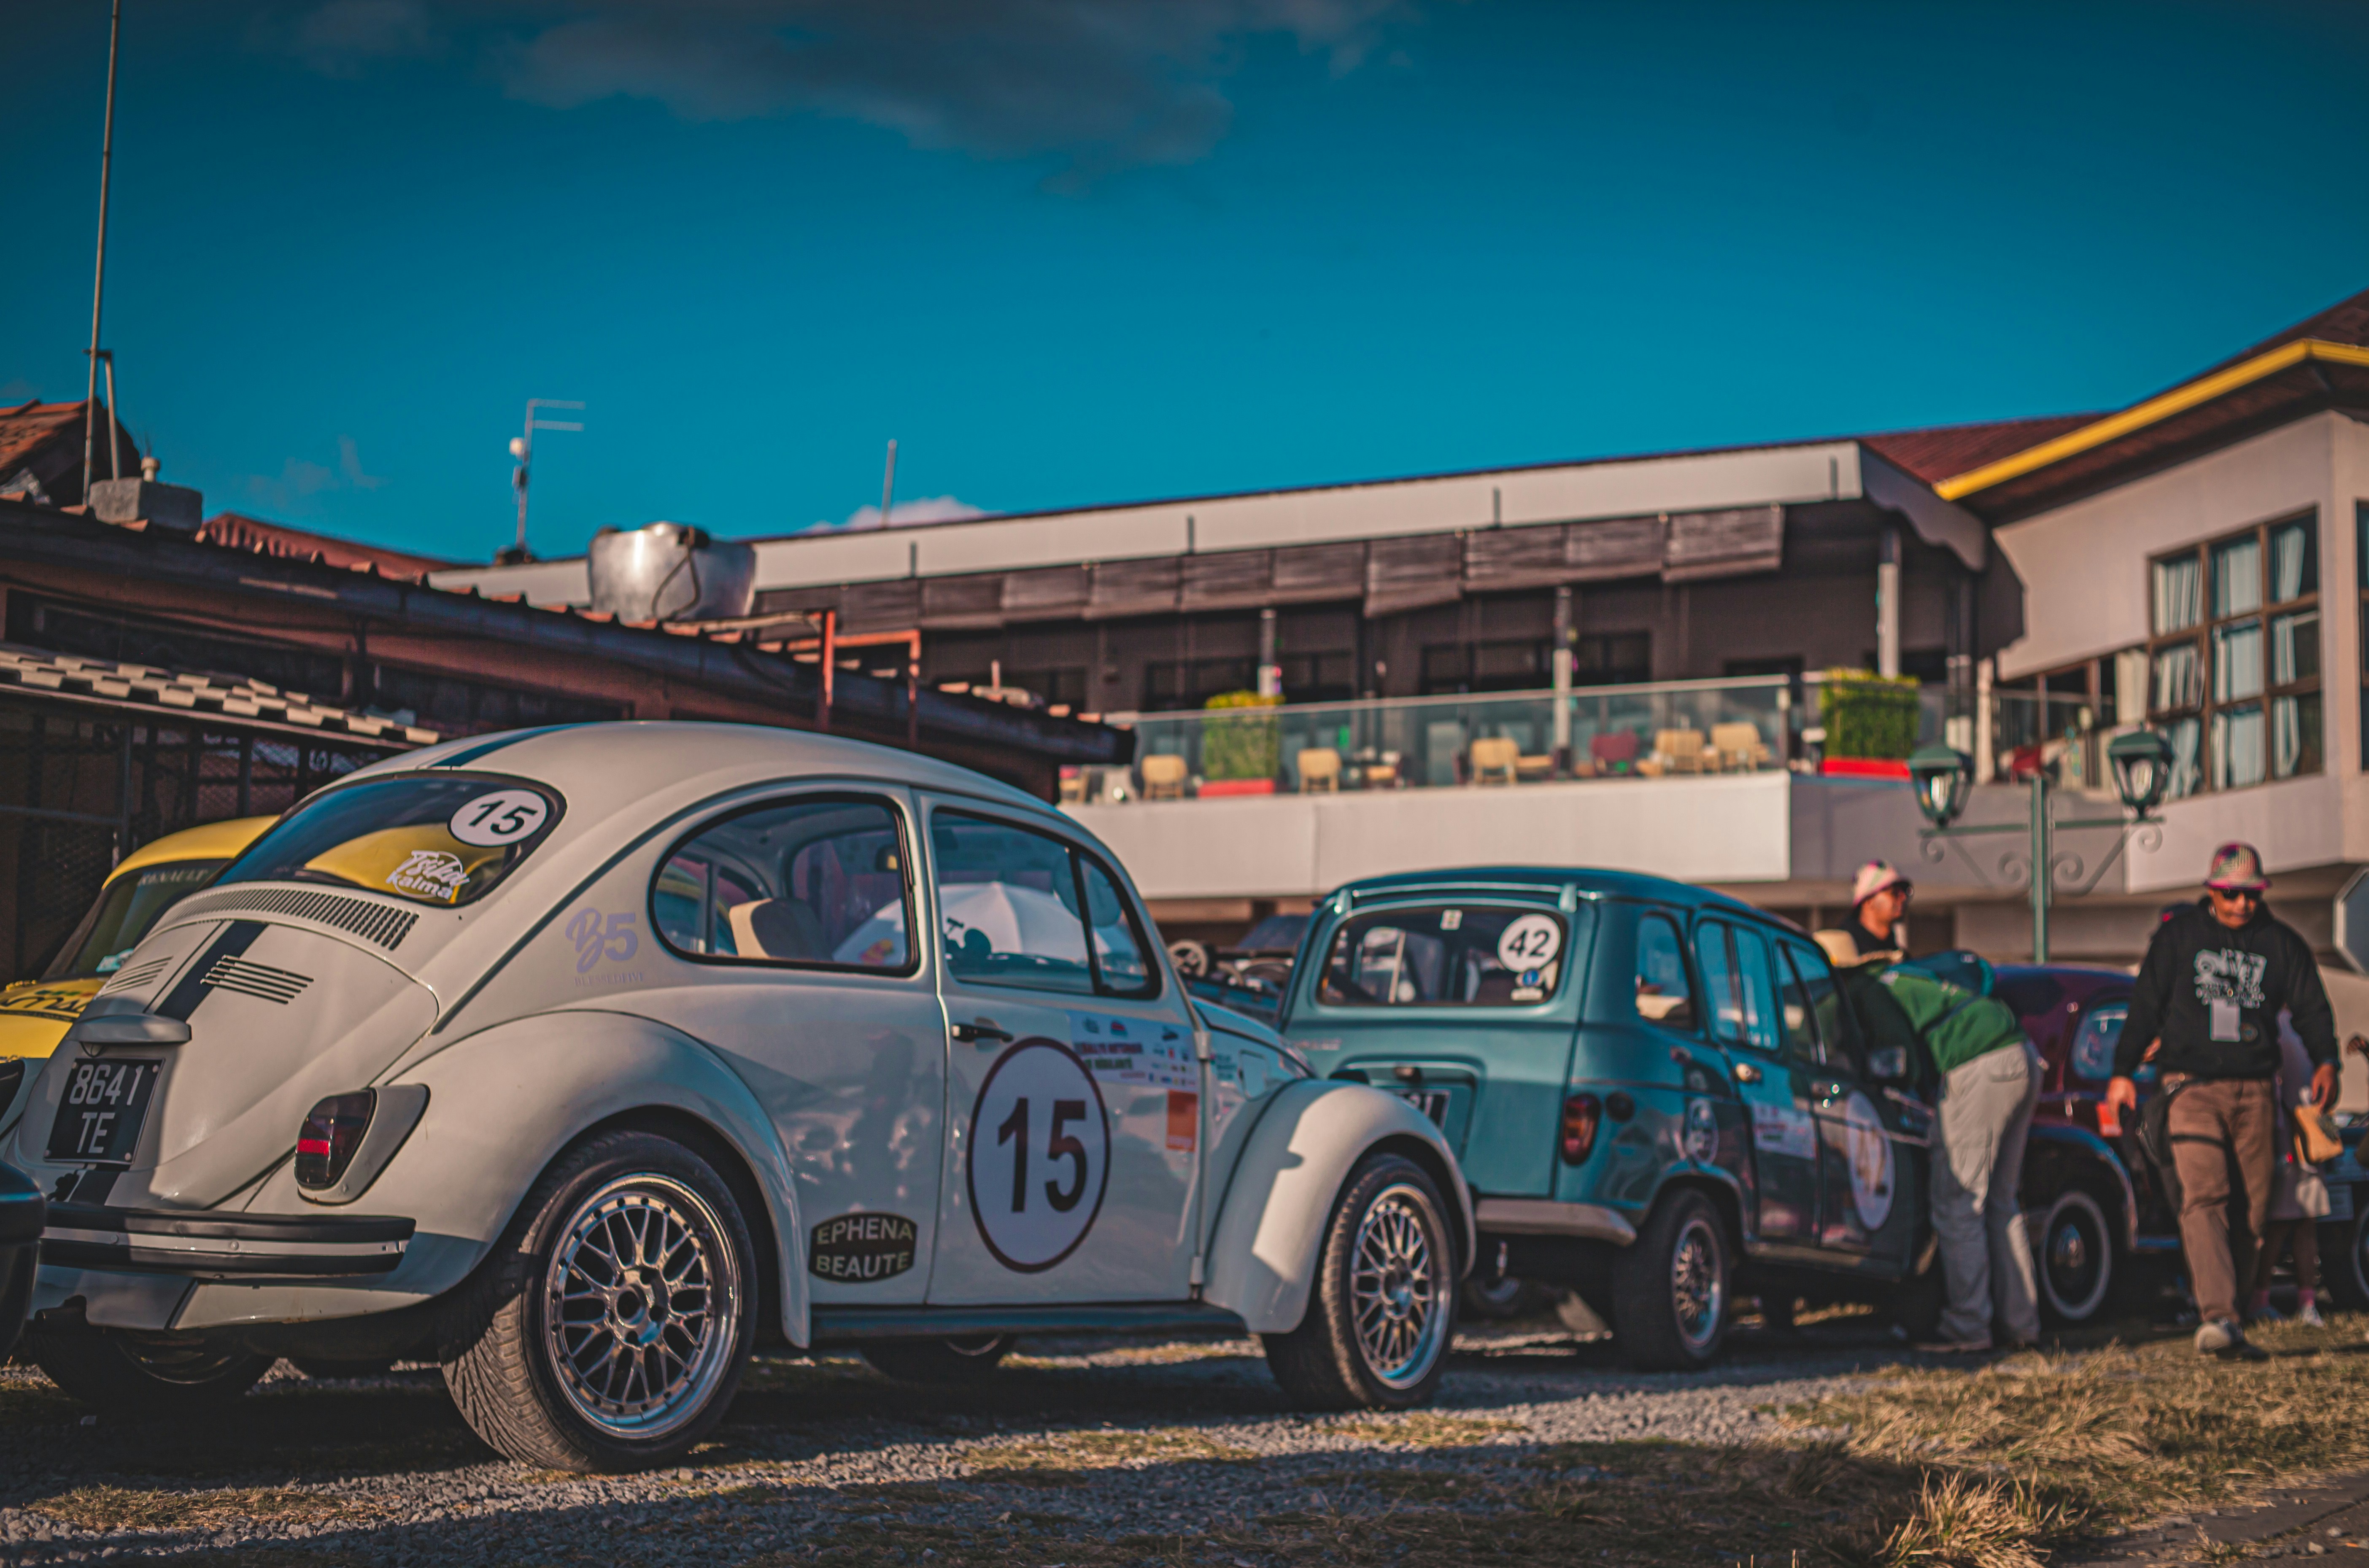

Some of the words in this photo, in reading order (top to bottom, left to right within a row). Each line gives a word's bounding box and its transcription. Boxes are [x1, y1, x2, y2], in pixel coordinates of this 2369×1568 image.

[469, 800, 538, 835] 15
[1508, 929, 1550, 957] 42
[69, 1064, 144, 1105] 8641
[77, 1112, 115, 1153] TE
[998, 1097, 1088, 1213] 15
[817, 1217, 914, 1244] EPHENA
[816, 1251, 910, 1279] BEAUTE
